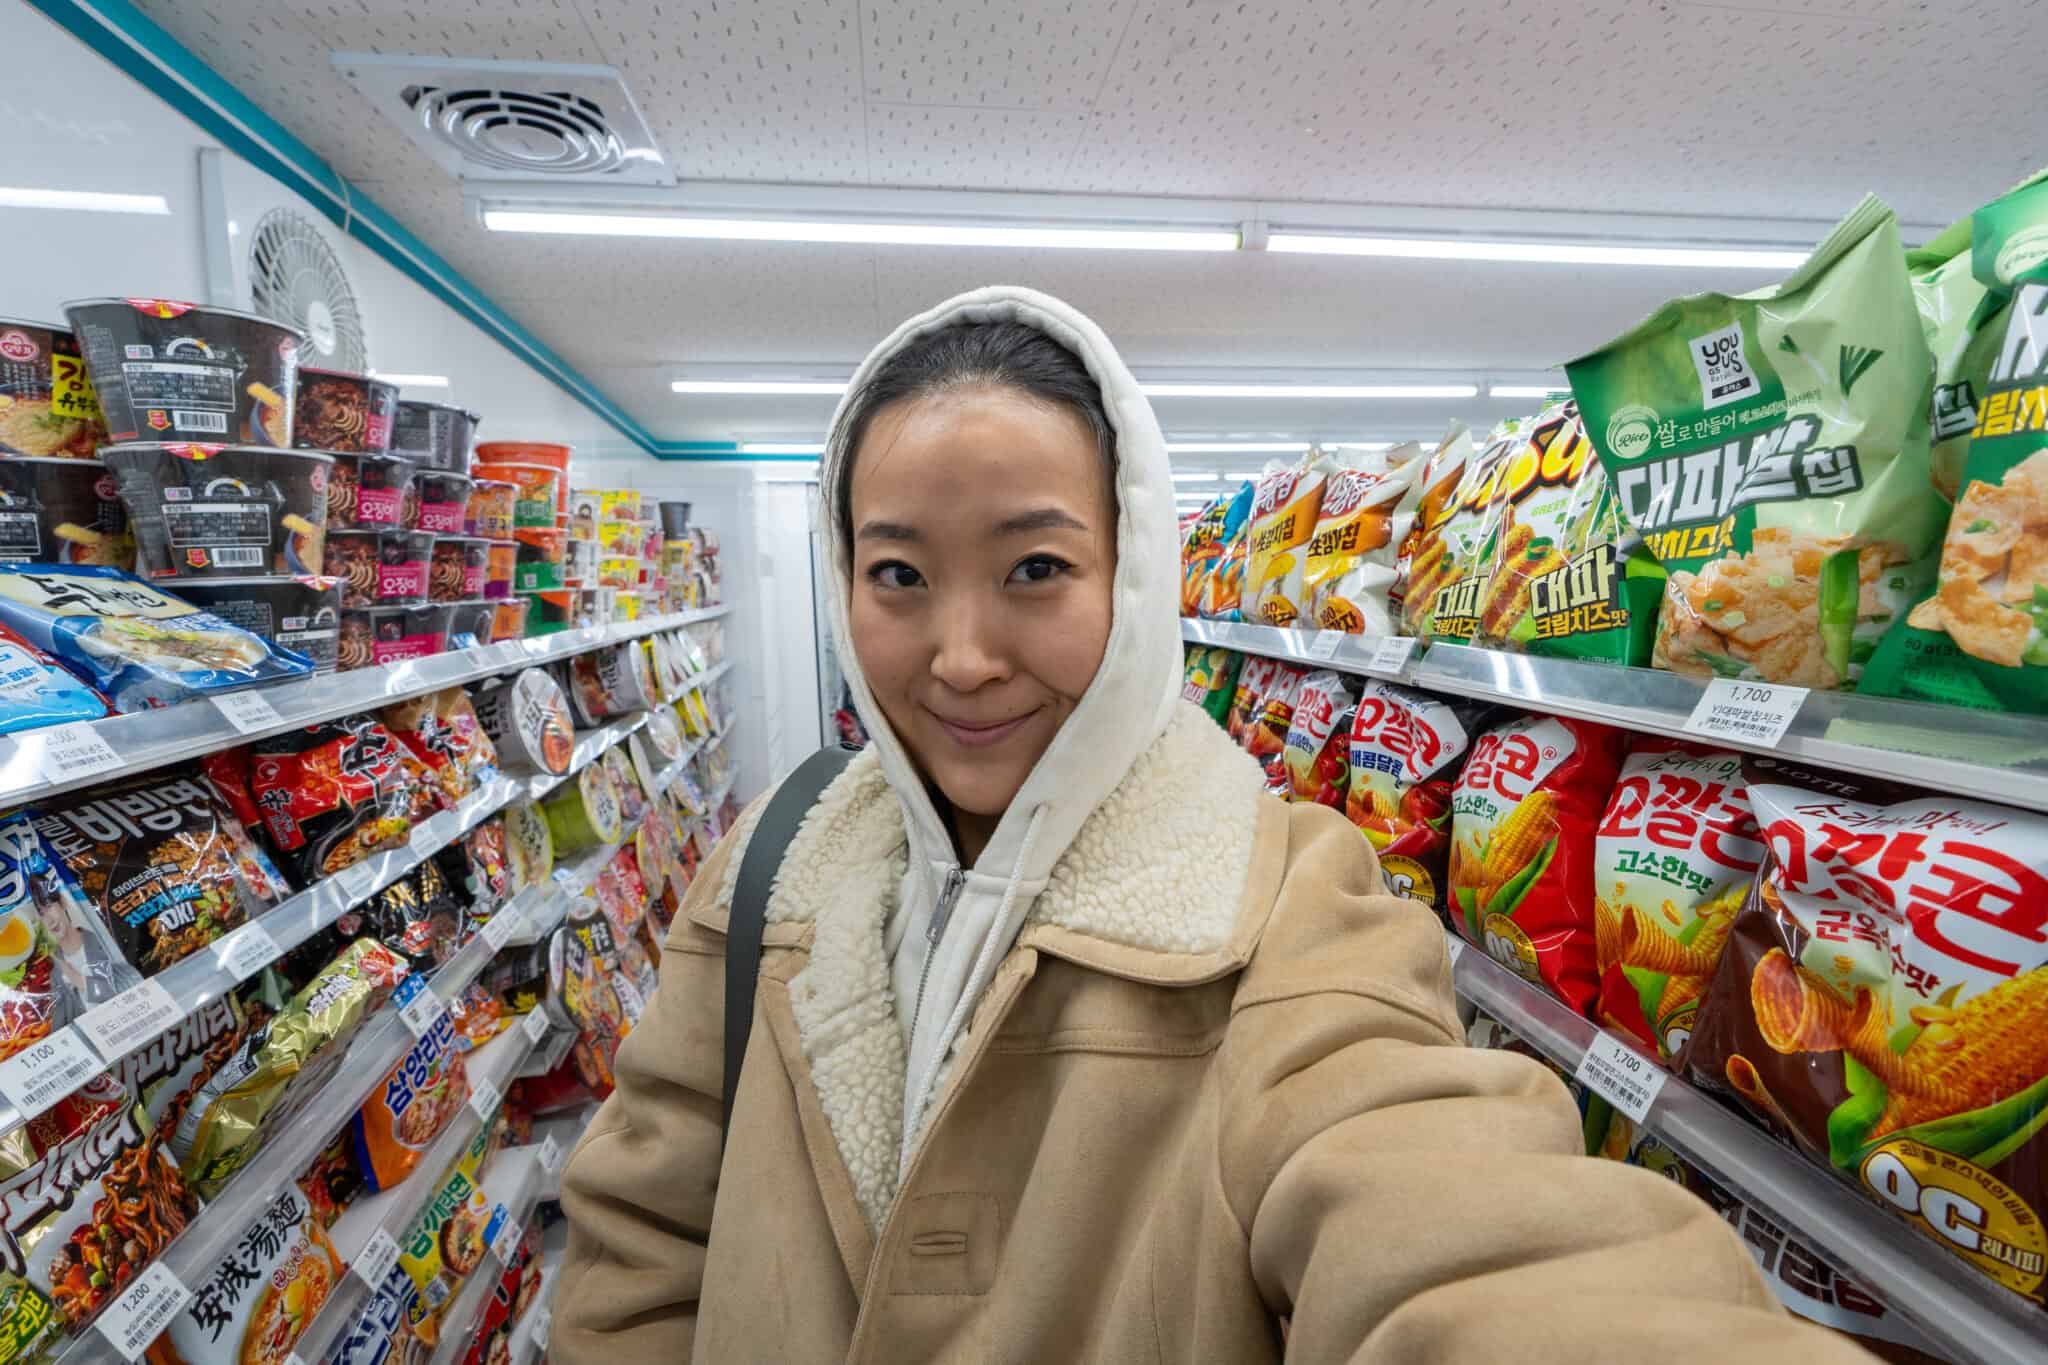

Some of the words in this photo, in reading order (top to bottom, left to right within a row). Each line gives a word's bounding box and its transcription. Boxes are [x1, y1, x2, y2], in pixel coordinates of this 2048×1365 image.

[1694, 411, 1737, 438] 만들어
[1530, 547, 1616, 618] 대파
[1536, 602, 1629, 638] 크림치즈맛
[1731, 686, 1773, 703] 1,700
[1776, 766, 1862, 796] LOTTE
[1613, 849, 1714, 896] 고소한맛
[1613, 1048, 1641, 1073] 1,700
[1981, 1236, 2042, 1274] 레시피
[122, 1283, 150, 1312] 1,200
